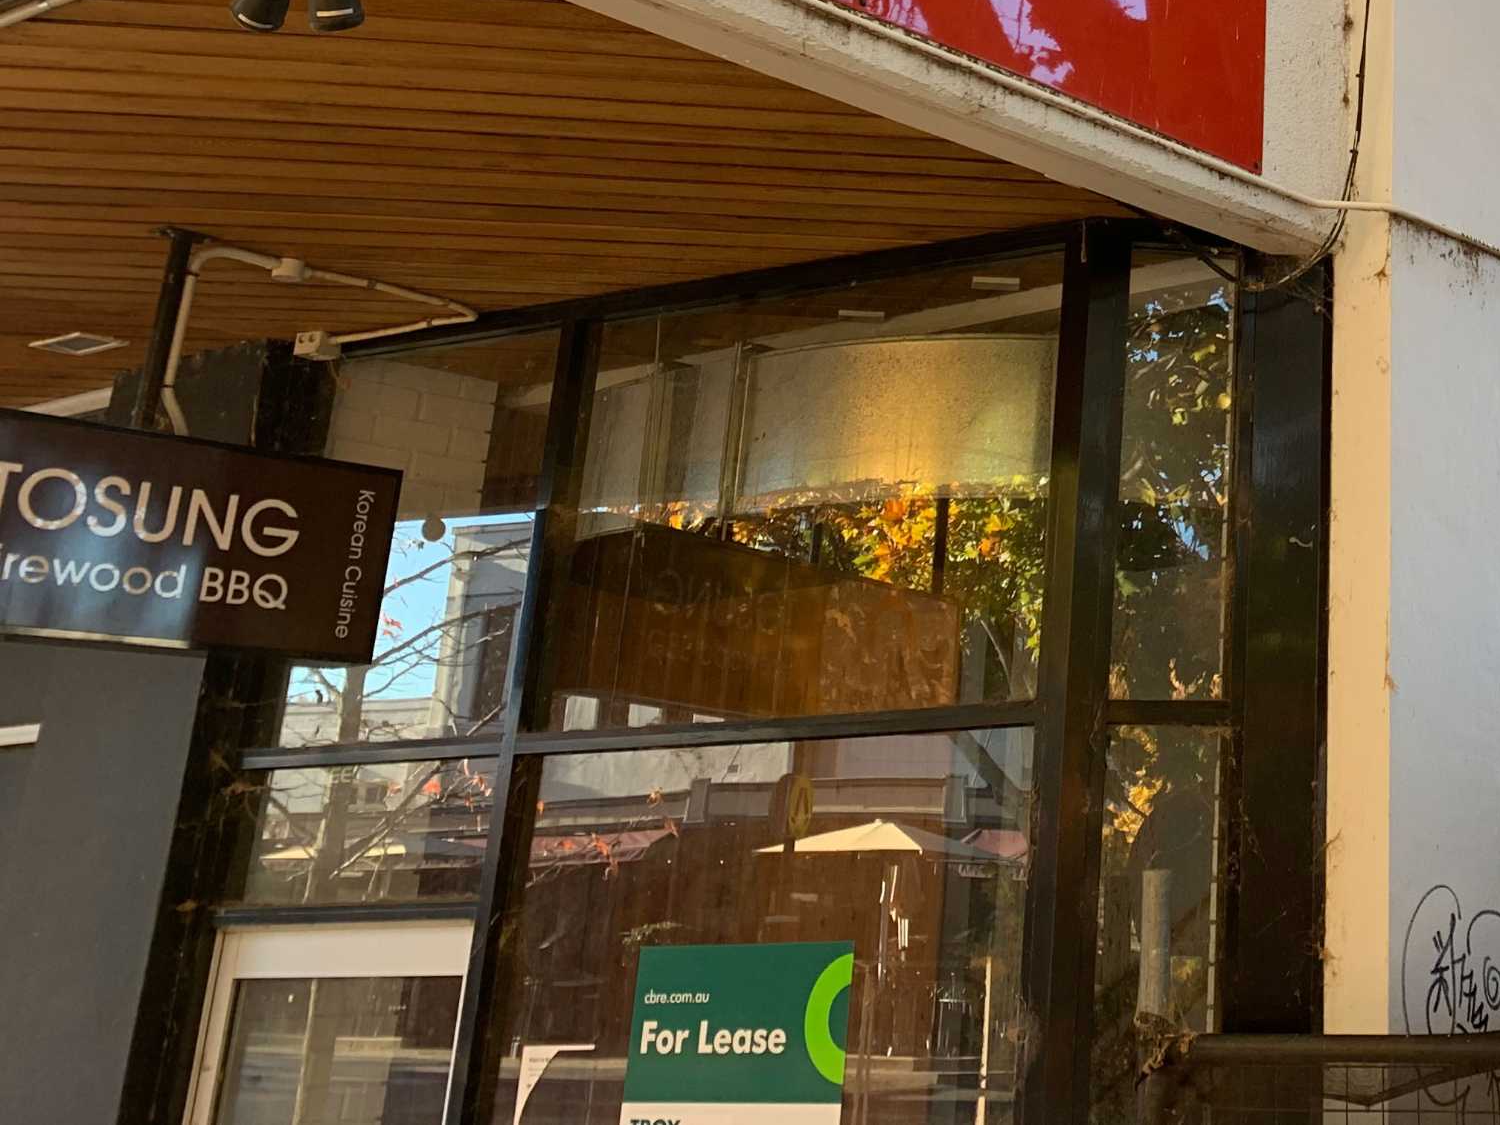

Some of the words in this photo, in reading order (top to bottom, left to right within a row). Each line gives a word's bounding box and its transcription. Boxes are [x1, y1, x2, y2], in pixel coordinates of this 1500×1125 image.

[345, 488, 375, 562] Korean
[0, 543, 188, 599] rewood
[199, 567, 289, 610] BBQ
[334, 565, 362, 639] Cuisine
[644, 989, 710, 1005] cbre.com.au
[640, 1020, 690, 1055] For
[697, 1020, 787, 1055] Lease
